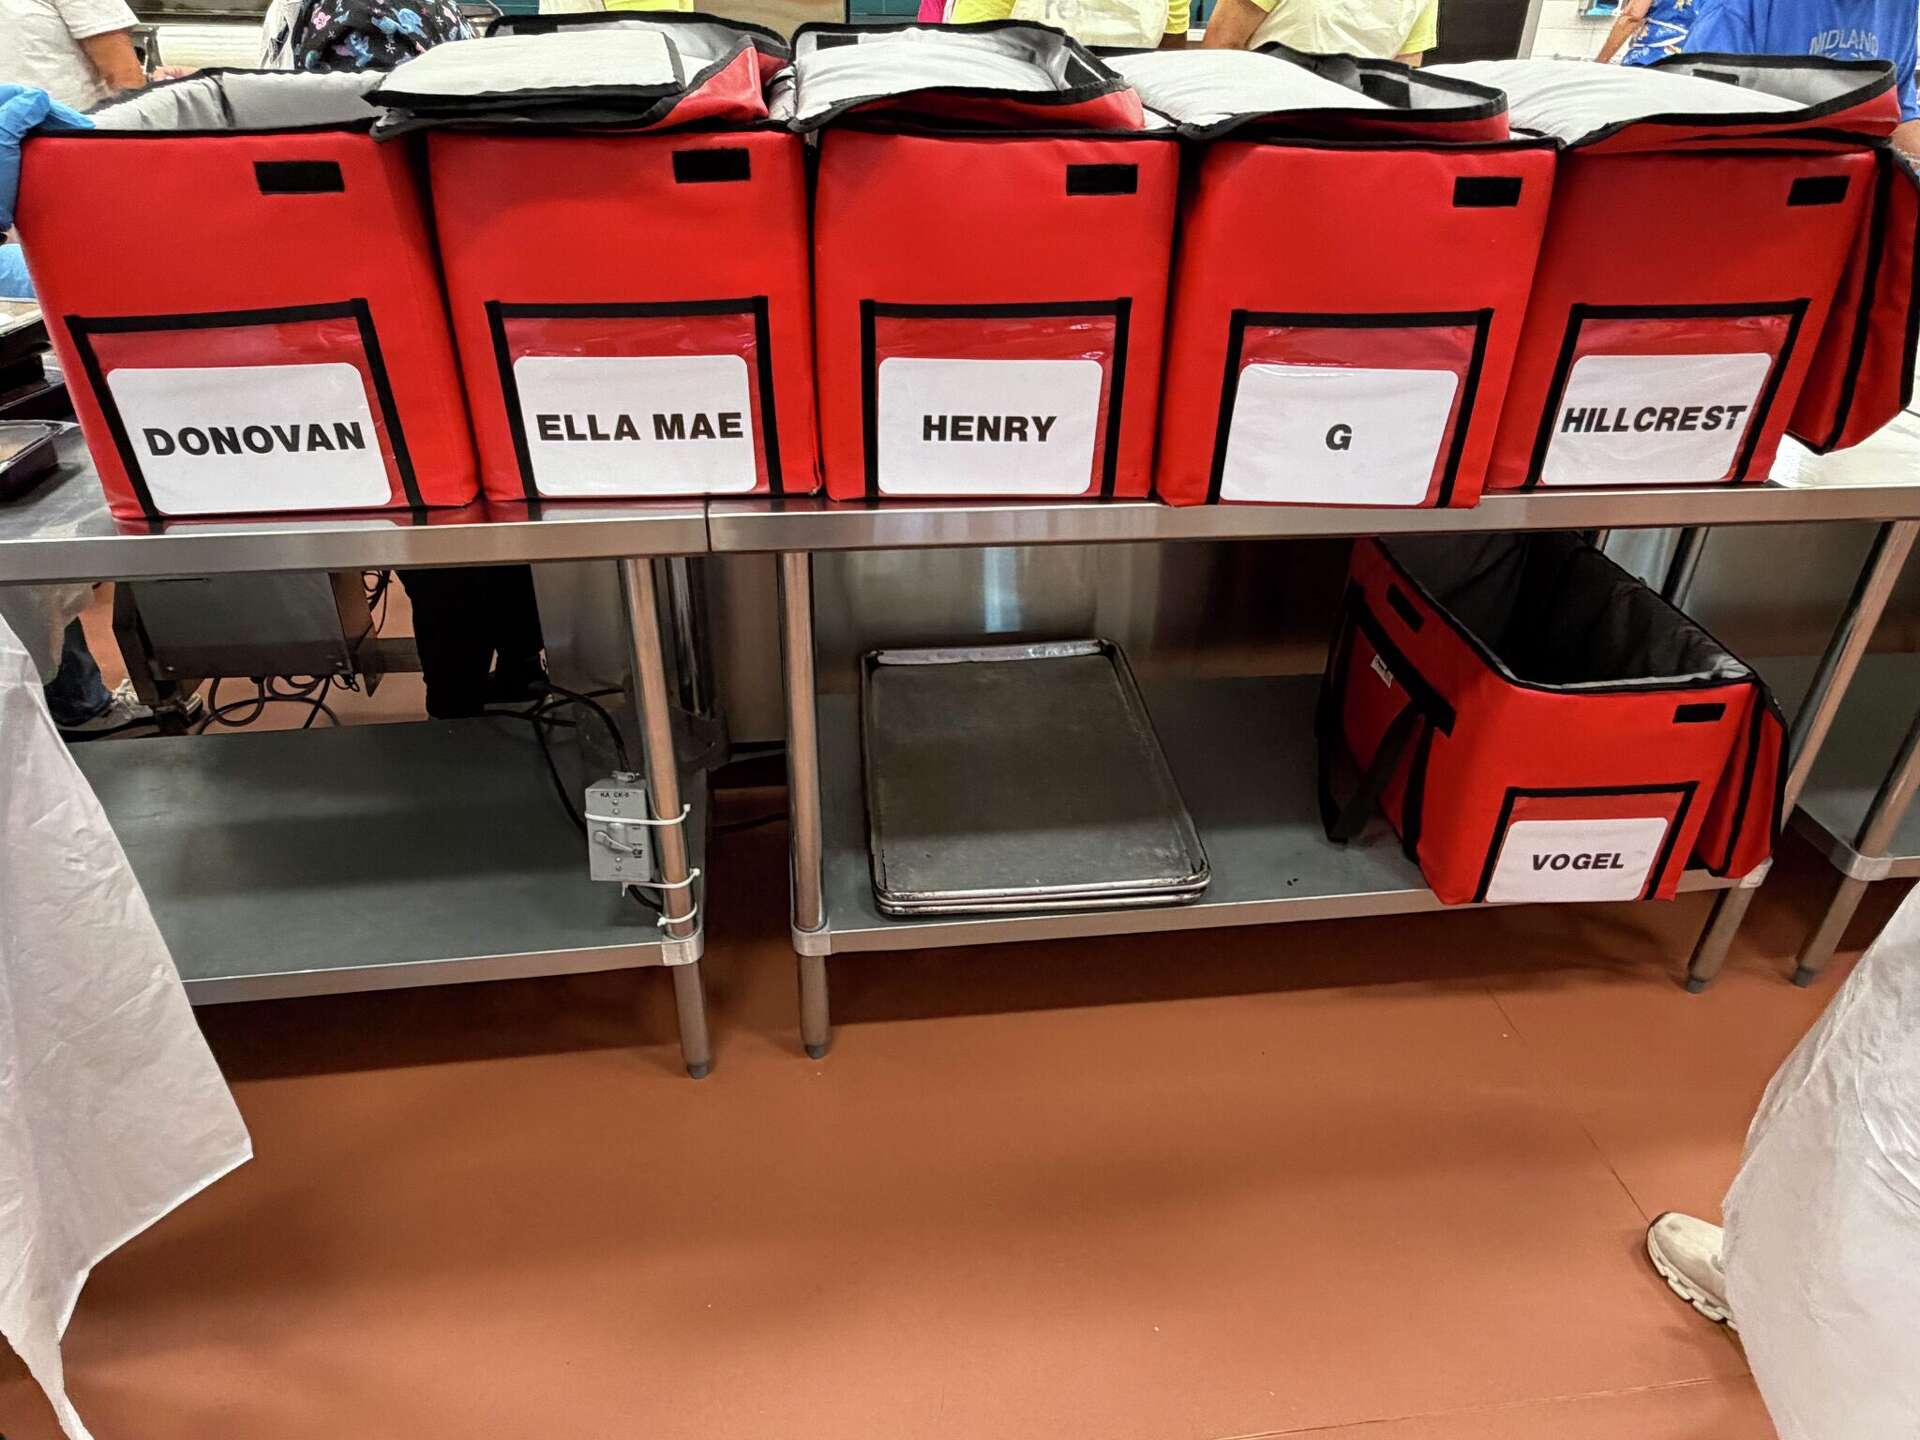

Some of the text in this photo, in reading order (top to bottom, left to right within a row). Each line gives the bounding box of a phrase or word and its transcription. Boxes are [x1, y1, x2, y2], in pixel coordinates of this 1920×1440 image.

[1808, 28, 1879, 57] MIDLAND
[536, 412, 744, 441] ELLA MAE
[922, 415, 1057, 442] HENRY
[1561, 405, 1747, 433] HILLCREST
[142, 422, 366, 457] DONOVAN
[1325, 423, 1352, 450] G
[1533, 852, 1625, 871] VOGEL
